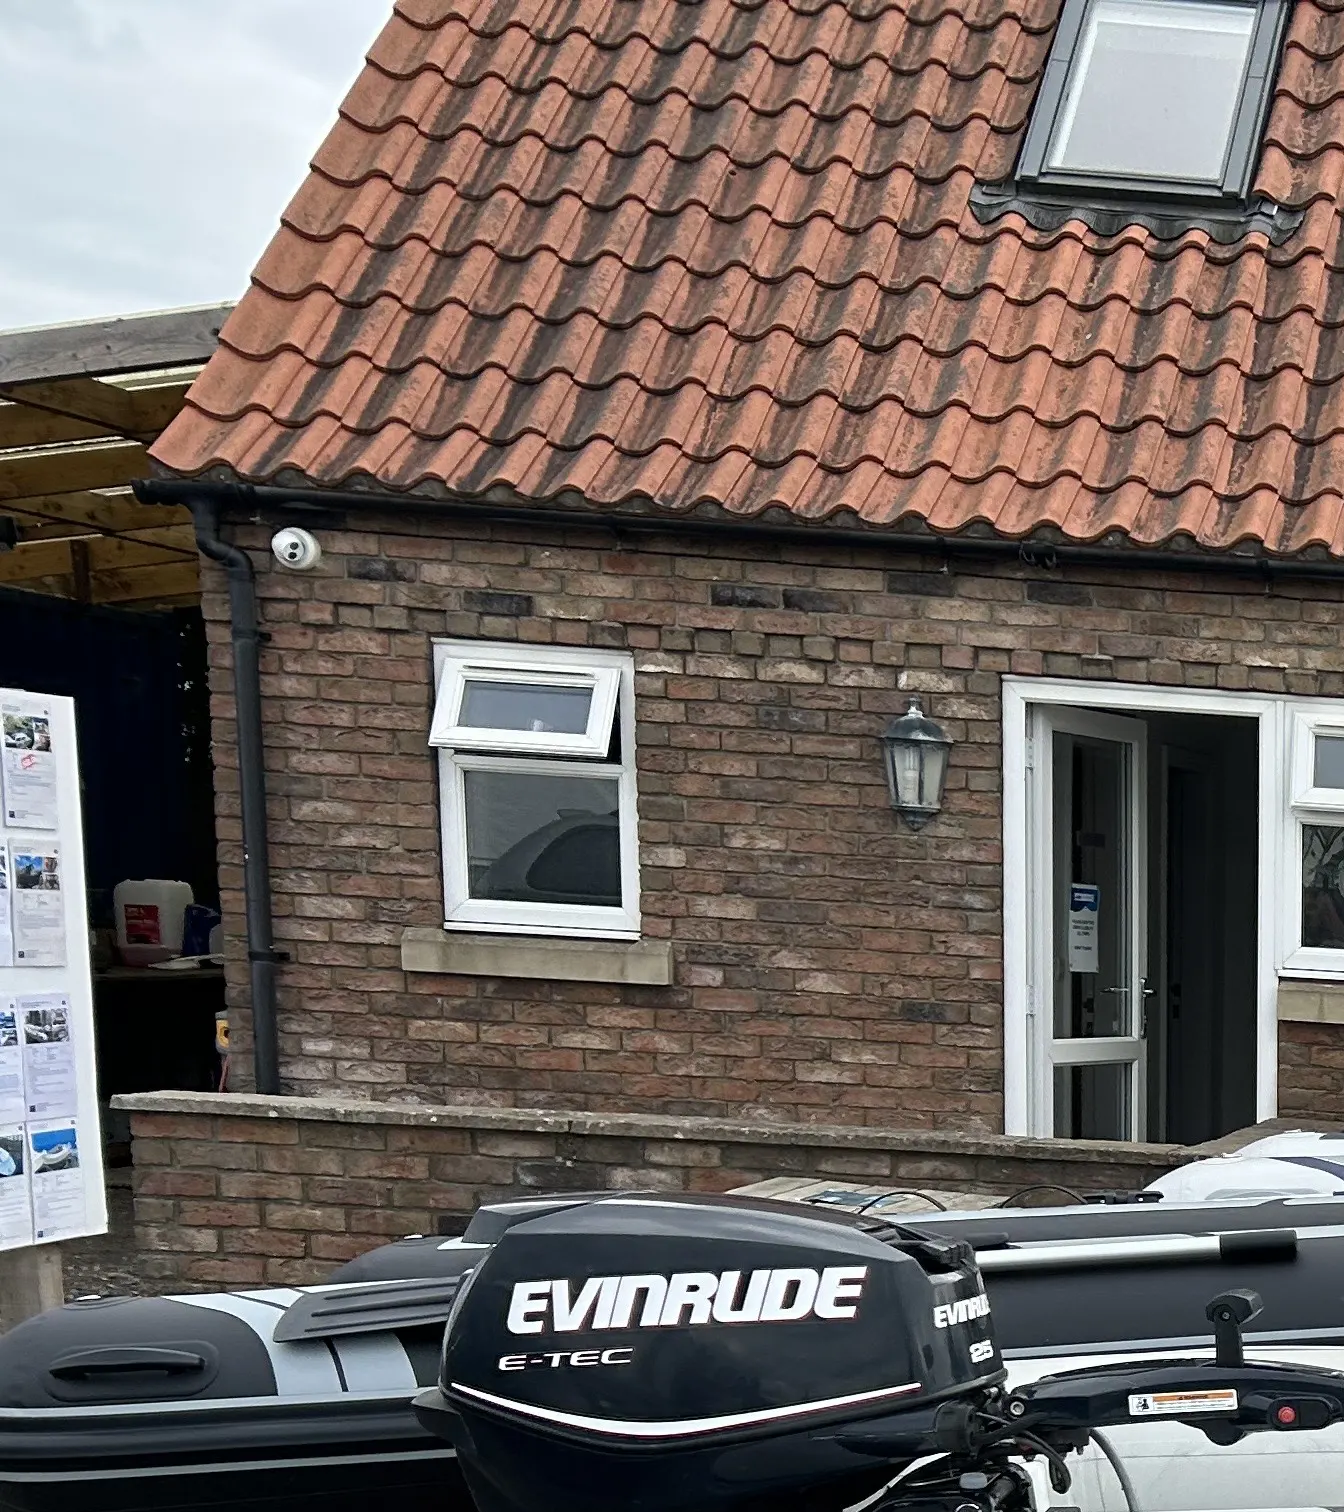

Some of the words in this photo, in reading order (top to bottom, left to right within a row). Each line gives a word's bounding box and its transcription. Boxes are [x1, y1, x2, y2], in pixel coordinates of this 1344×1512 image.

[506, 1265, 868, 1335] EVINRUDE
[498, 1347, 634, 1371] E-TEC
[969, 1339, 994, 1363] 25
